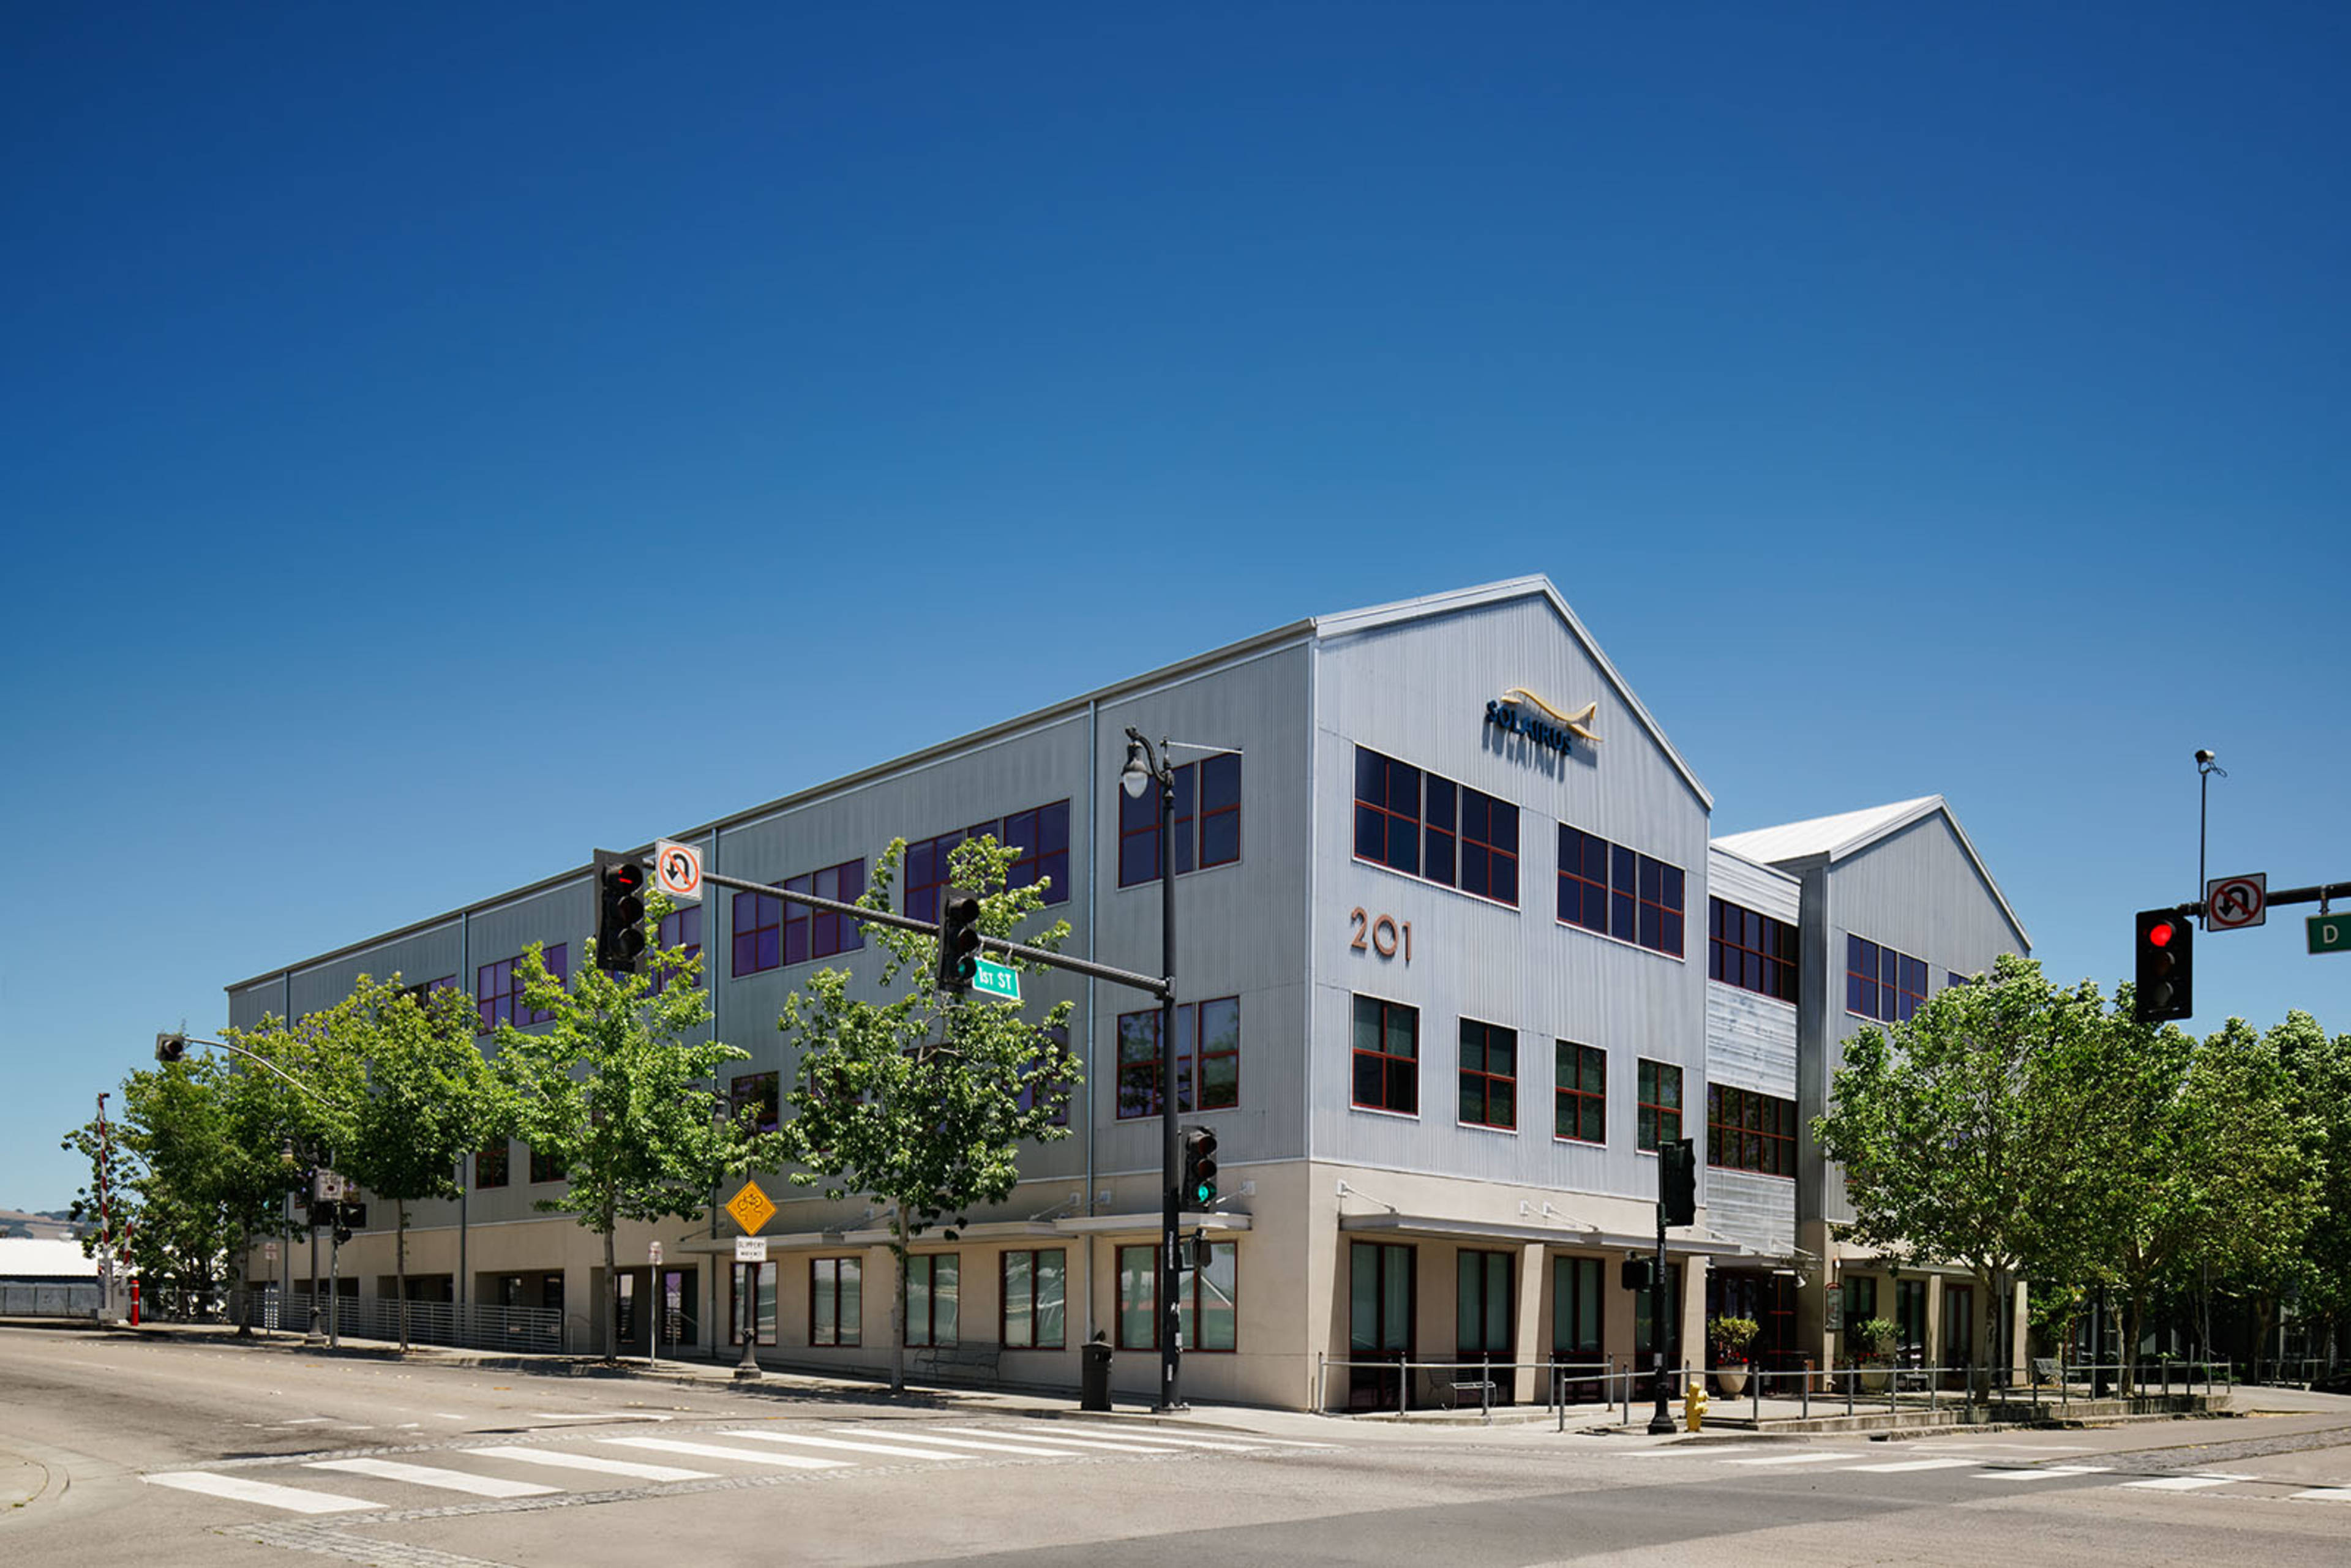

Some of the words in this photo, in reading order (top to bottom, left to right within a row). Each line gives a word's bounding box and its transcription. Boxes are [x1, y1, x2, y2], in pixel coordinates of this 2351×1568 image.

[1485, 700, 1572, 756] SOLAIRUS
[1351, 907, 1411, 961] 201
[2323, 925, 2338, 943] D
[978, 967, 993, 985] 1ST
[998, 972, 1011, 990] ST
